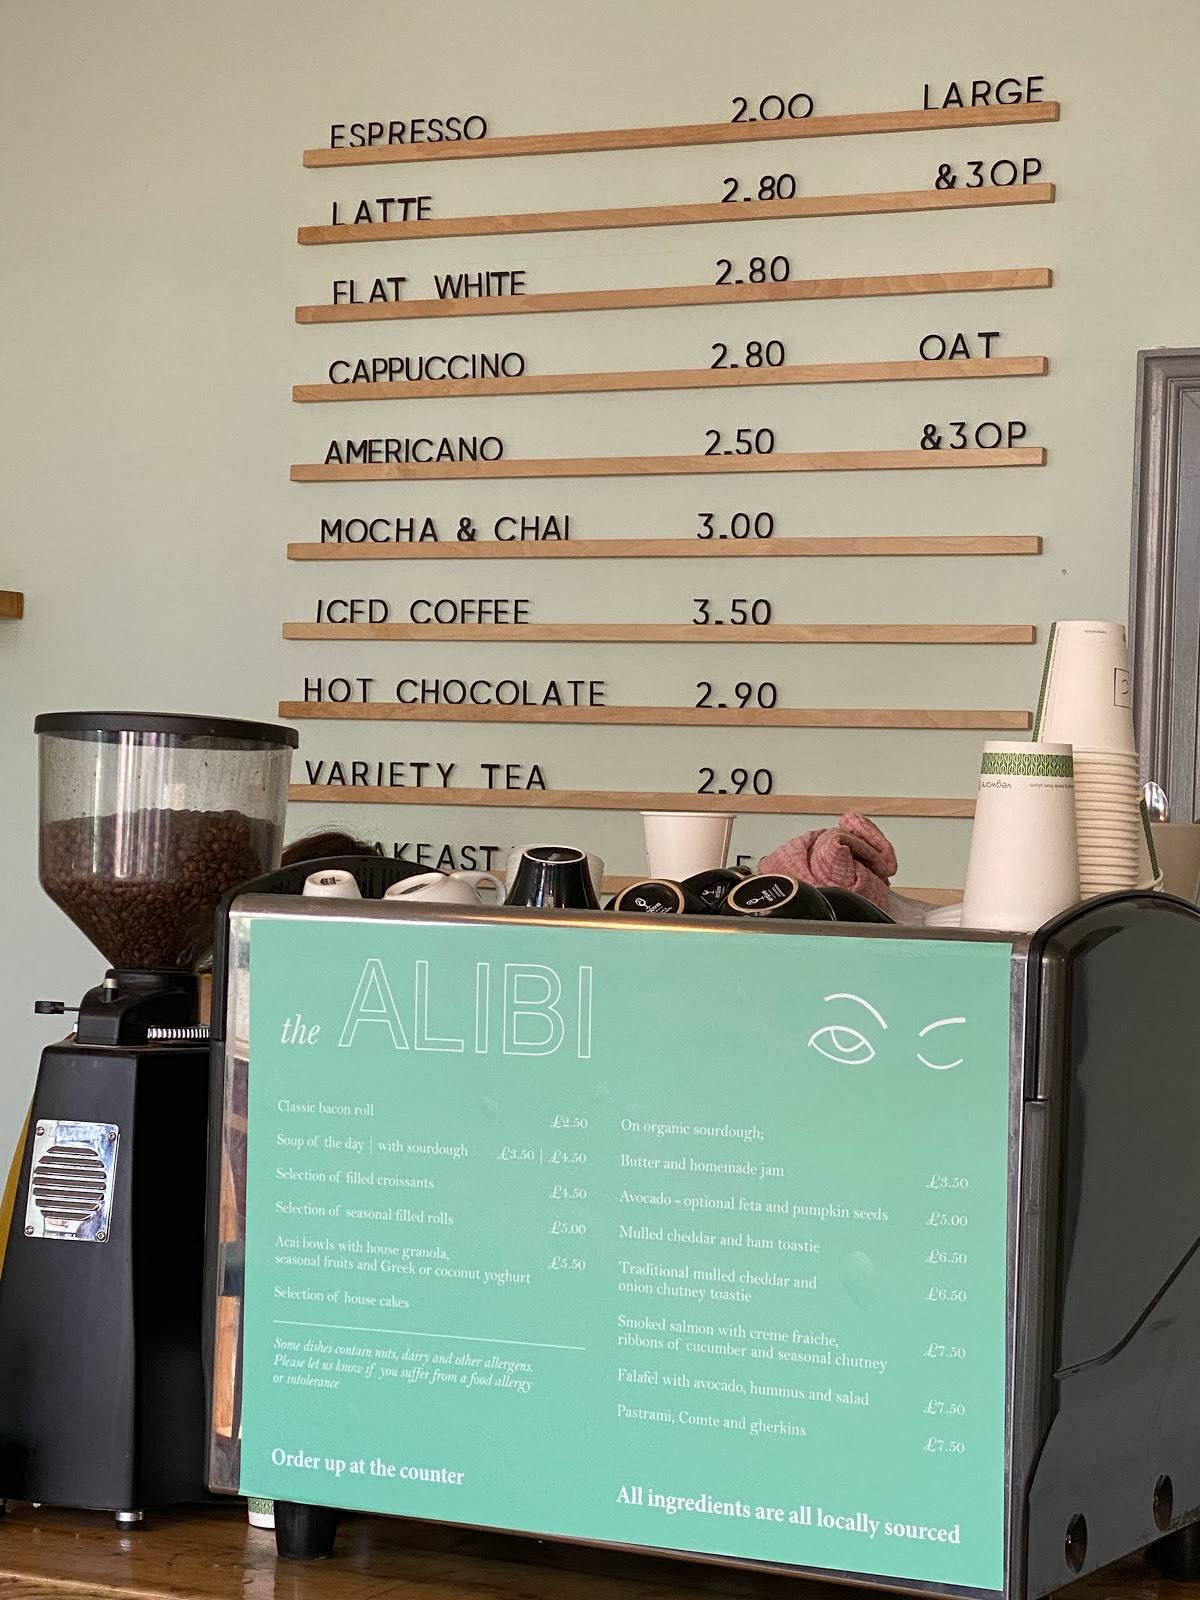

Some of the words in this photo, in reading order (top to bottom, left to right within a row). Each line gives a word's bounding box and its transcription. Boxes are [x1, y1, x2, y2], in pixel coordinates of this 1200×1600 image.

[924, 76, 1043, 110] LARGE
[331, 116, 487, 148] ESPRESSO
[722, 174, 796, 203] 2.80
[333, 196, 431, 226] LATTE
[716, 256, 789, 285] 2.80
[334, 277, 406, 305] FLAT
[434, 271, 525, 299] WHITE
[711, 341, 784, 369] 2.80
[920, 332, 999, 360] OAT
[329, 353, 524, 384] CAPPUCCINO
[325, 437, 503, 464] AMERICANO
[705, 429, 774, 455] 2.50
[321, 518, 438, 543] MOCHA
[457, 517, 476, 541] &
[495, 516, 569, 541] CHAI
[697, 513, 773, 539] 3.00
[410, 600, 529, 624] COFFEE
[693, 599, 771, 625] 3.50
[305, 678, 373, 703] HOT
[397, 679, 605, 706] CHOCOLATE
[696, 682, 777, 708] 2.90
[306, 761, 454, 788] VARIETY
[481, 764, 546, 790] TEA
[698, 768, 772, 795] 2.90
[280, 1014, 321, 1044] the
[337, 958, 593, 1058] ALIBI
[277, 1100, 316, 1112] Classic
[318, 1102, 351, 1115] bacon
[354, 1104, 374, 1116] roll
[549, 1115, 588, 1128] £2.50
[620, 1119, 640, 1131] On
[643, 1122, 691, 1137] organic
[693, 1124, 765, 1142] sourdough;
[276, 1134, 305, 1150] Soup
[306, 1136, 320, 1147] of
[323, 1136, 343, 1148] the
[344, 1137, 365, 1154] day
[377, 1140, 404, 1152] with
[405, 1142, 469, 1159] sourdough
[495, 1147, 535, 1160] £3.50
[547, 1150, 587, 1163] £4.50
[275, 1167, 326, 1181] Selection
[328, 1171, 343, 1183] of
[345, 1171, 374, 1184] filled
[376, 1175, 435, 1188] croissants
[620, 1154, 661, 1168] Butter
[663, 1157, 686, 1170] and
[689, 1158, 758, 1175] homemade
[758, 1162, 785, 1179] jam
[548, 1185, 588, 1200] £4.50
[925, 1175, 969, 1189] £3.50
[275, 1201, 326, 1215] Selection
[328, 1205, 342, 1216] of
[345, 1208, 393, 1220] seasonal
[395, 1209, 424, 1222] filled
[427, 1212, 454, 1224] rolls
[619, 1190, 672, 1205] Avocado
[683, 1195, 736, 1211] optional
[738, 1198, 763, 1211] feta
[765, 1200, 789, 1213] and
[792, 1204, 850, 1220] pumpkin
[853, 1207, 889, 1220] seeds
[547, 1221, 587, 1235] £5.00
[924, 1212, 968, 1226] £5.00
[274, 1236, 300, 1248] Acai
[302, 1236, 335, 1250] bowls
[338, 1240, 363, 1252] with
[366, 1241, 400, 1255] house
[401, 1246, 451, 1261] granola,
[619, 1225, 663, 1240] Mulled
[666, 1229, 717, 1244] cheddar
[719, 1234, 743, 1246] and
[746, 1234, 774, 1248] ham
[778, 1239, 821, 1252] toastie
[546, 1256, 586, 1270] £5.50
[924, 1249, 968, 1264] £6.50
[274, 1255, 321, 1267] seasonal
[323, 1256, 354, 1270] fruits
[356, 1259, 378, 1271] and
[380, 1260, 416, 1274] Greek
[434, 1268, 481, 1279] coconut
[482, 1269, 531, 1285] yoghurt
[618, 1261, 689, 1278] Traditional
[693, 1268, 736, 1282] mulled
[739, 1270, 791, 1287] cheddar
[793, 1276, 817, 1289] and
[273, 1286, 324, 1301] Selection
[326, 1291, 341, 1302] of
[343, 1291, 377, 1305] house
[379, 1295, 410, 1308] cakes
[617, 1280, 653, 1294] onion
[656, 1282, 706, 1302] chutney
[710, 1289, 752, 1302] toastie
[924, 1287, 967, 1301] £6.50
[617, 1314, 666, 1330] Smoked
[669, 1320, 714, 1335] salmon
[718, 1324, 746, 1338] with
[749, 1330, 789, 1342] creme
[792, 1330, 840, 1348] fraiche,
[273, 1337, 302, 1351] Some
[303, 1339, 333, 1353] dishes
[334, 1344, 373, 1357] contain
[374, 1349, 399, 1361] nuts,
[401, 1348, 431, 1366] dairy
[431, 1352, 454, 1364] and
[454, 1354, 483, 1367] other
[483, 1356, 534, 1374] allergens.
[617, 1333, 664, 1348] ribbons
[666, 1337, 683, 1350] of
[685, 1342, 748, 1356] cucumber
[750, 1346, 774, 1359] and
[777, 1351, 831, 1364] seasonal
[834, 1353, 888, 1374] chutney
[922, 1343, 967, 1358] £7.50
[273, 1354, 306, 1368] Please
[335, 1359, 364, 1374] know
[400, 1367, 430, 1384] suffer
[428, 1369, 458, 1384] from
[465, 1372, 494, 1388] food
[494, 1375, 533, 1393] allergy
[286, 1374, 341, 1388] intolerance
[617, 1369, 658, 1384] Falafel
[662, 1374, 690, 1387] with
[693, 1379, 747, 1395] avocado,
[749, 1380, 805, 1398] hummus
[808, 1388, 832, 1401] and
[835, 1391, 869, 1405] salad
[617, 1404, 675, 1424] Pastrami,
[678, 1411, 721, 1427] Comte
[723, 1417, 746, 1429] and
[749, 1418, 807, 1436] gherkins
[922, 1400, 966, 1415] £7.50
[922, 1437, 966, 1453] £7.50
[271, 1448, 321, 1469] Order
[324, 1458, 347, 1477] up
[349, 1459, 366, 1474] at
[369, 1458, 397, 1477] the
[399, 1467, 465, 1485] counter
[615, 1485, 644, 1505] All
[647, 1489, 751, 1518] ingredients
[754, 1507, 785, 1522] are
[788, 1505, 813, 1525] all
[815, 1508, 881, 1539] locally
[883, 1522, 961, 1544] sourced
